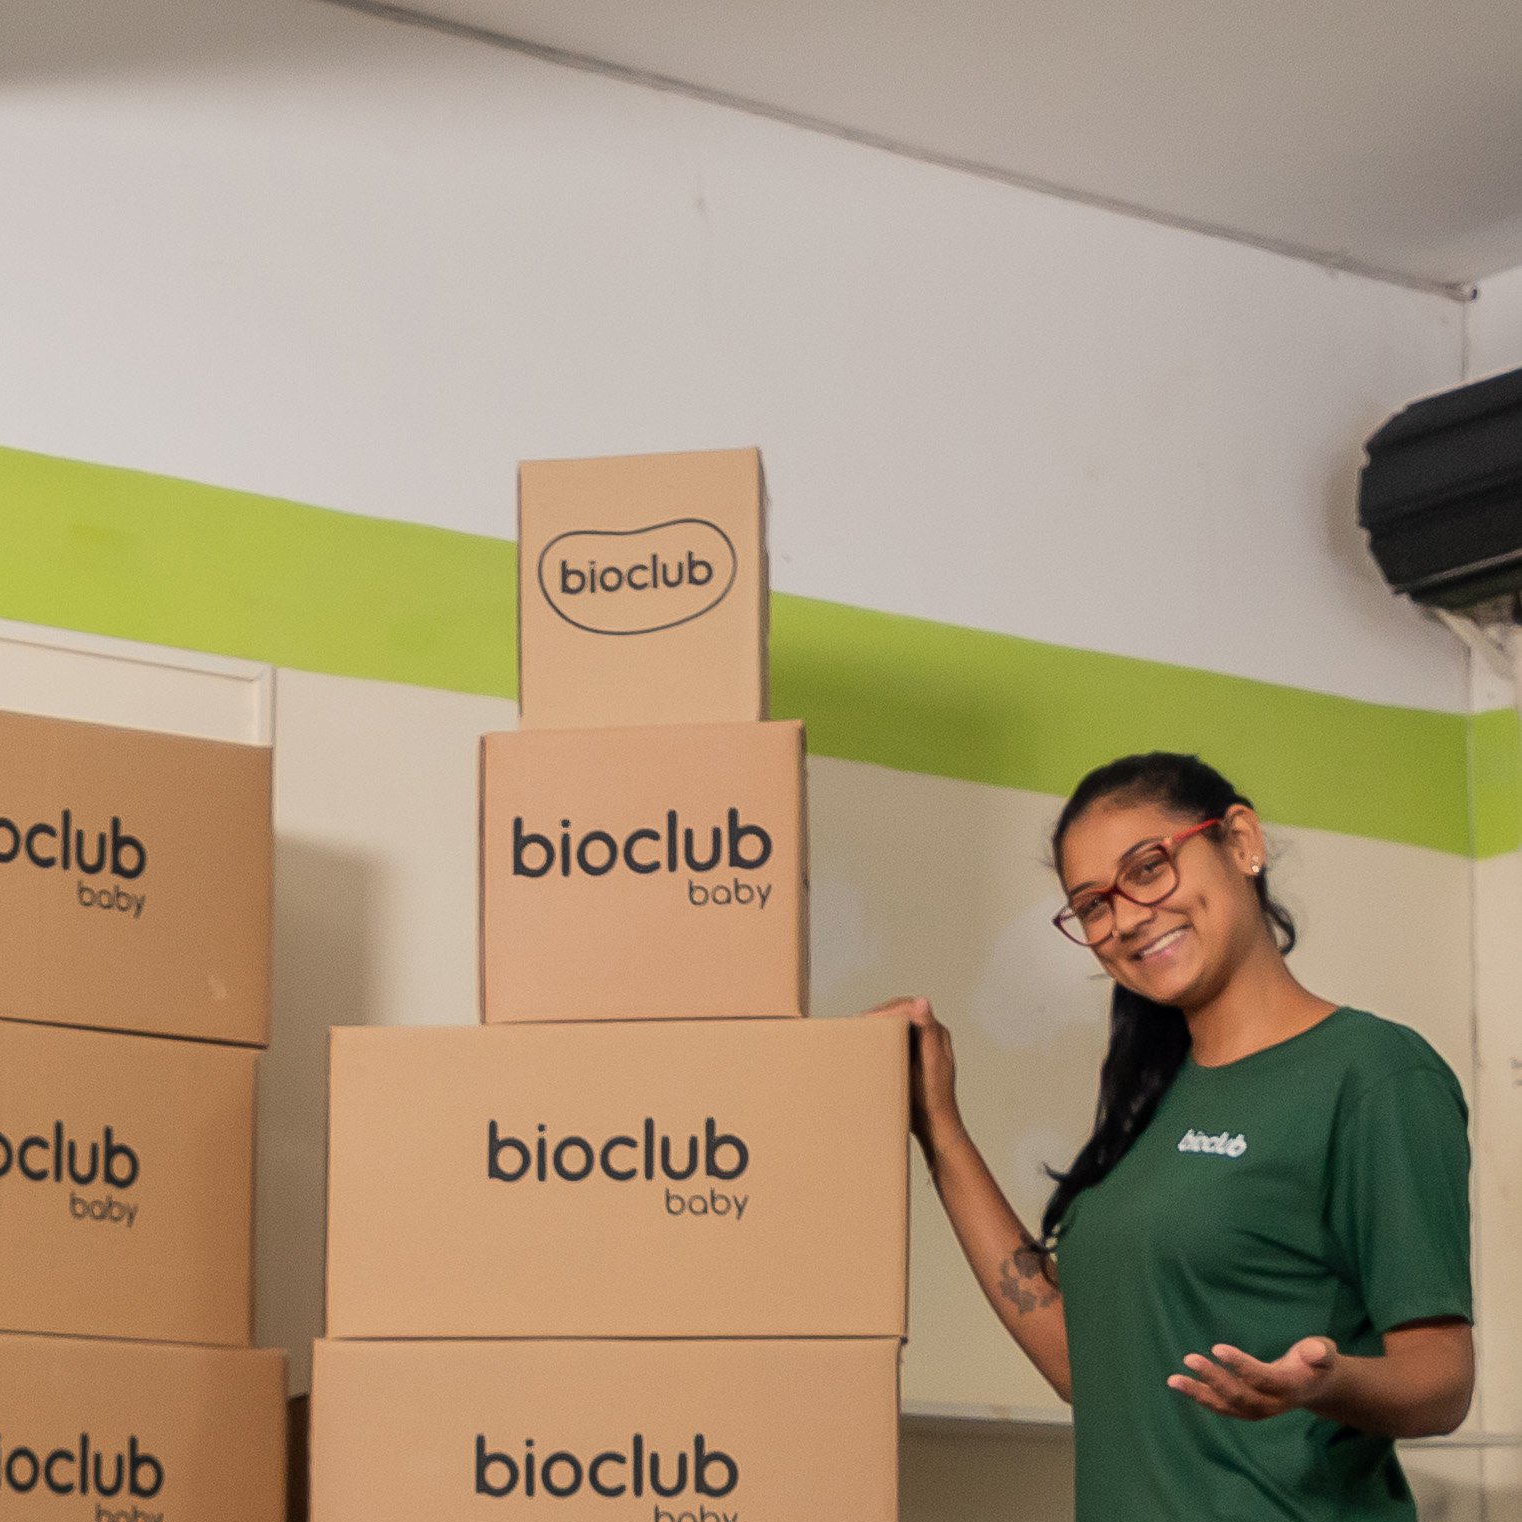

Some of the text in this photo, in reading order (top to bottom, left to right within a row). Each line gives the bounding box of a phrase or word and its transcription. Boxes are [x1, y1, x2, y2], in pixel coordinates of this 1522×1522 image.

[559, 549, 715, 596] bioclub
[512, 807, 773, 879] bioclub
[77, 881, 145, 918] baby
[688, 877, 772, 910] baby
[487, 1116, 750, 1183] bioclub
[69, 1196, 138, 1228] baby
[665, 1188, 748, 1221] baby
[474, 1433, 739, 1499] bioclub
